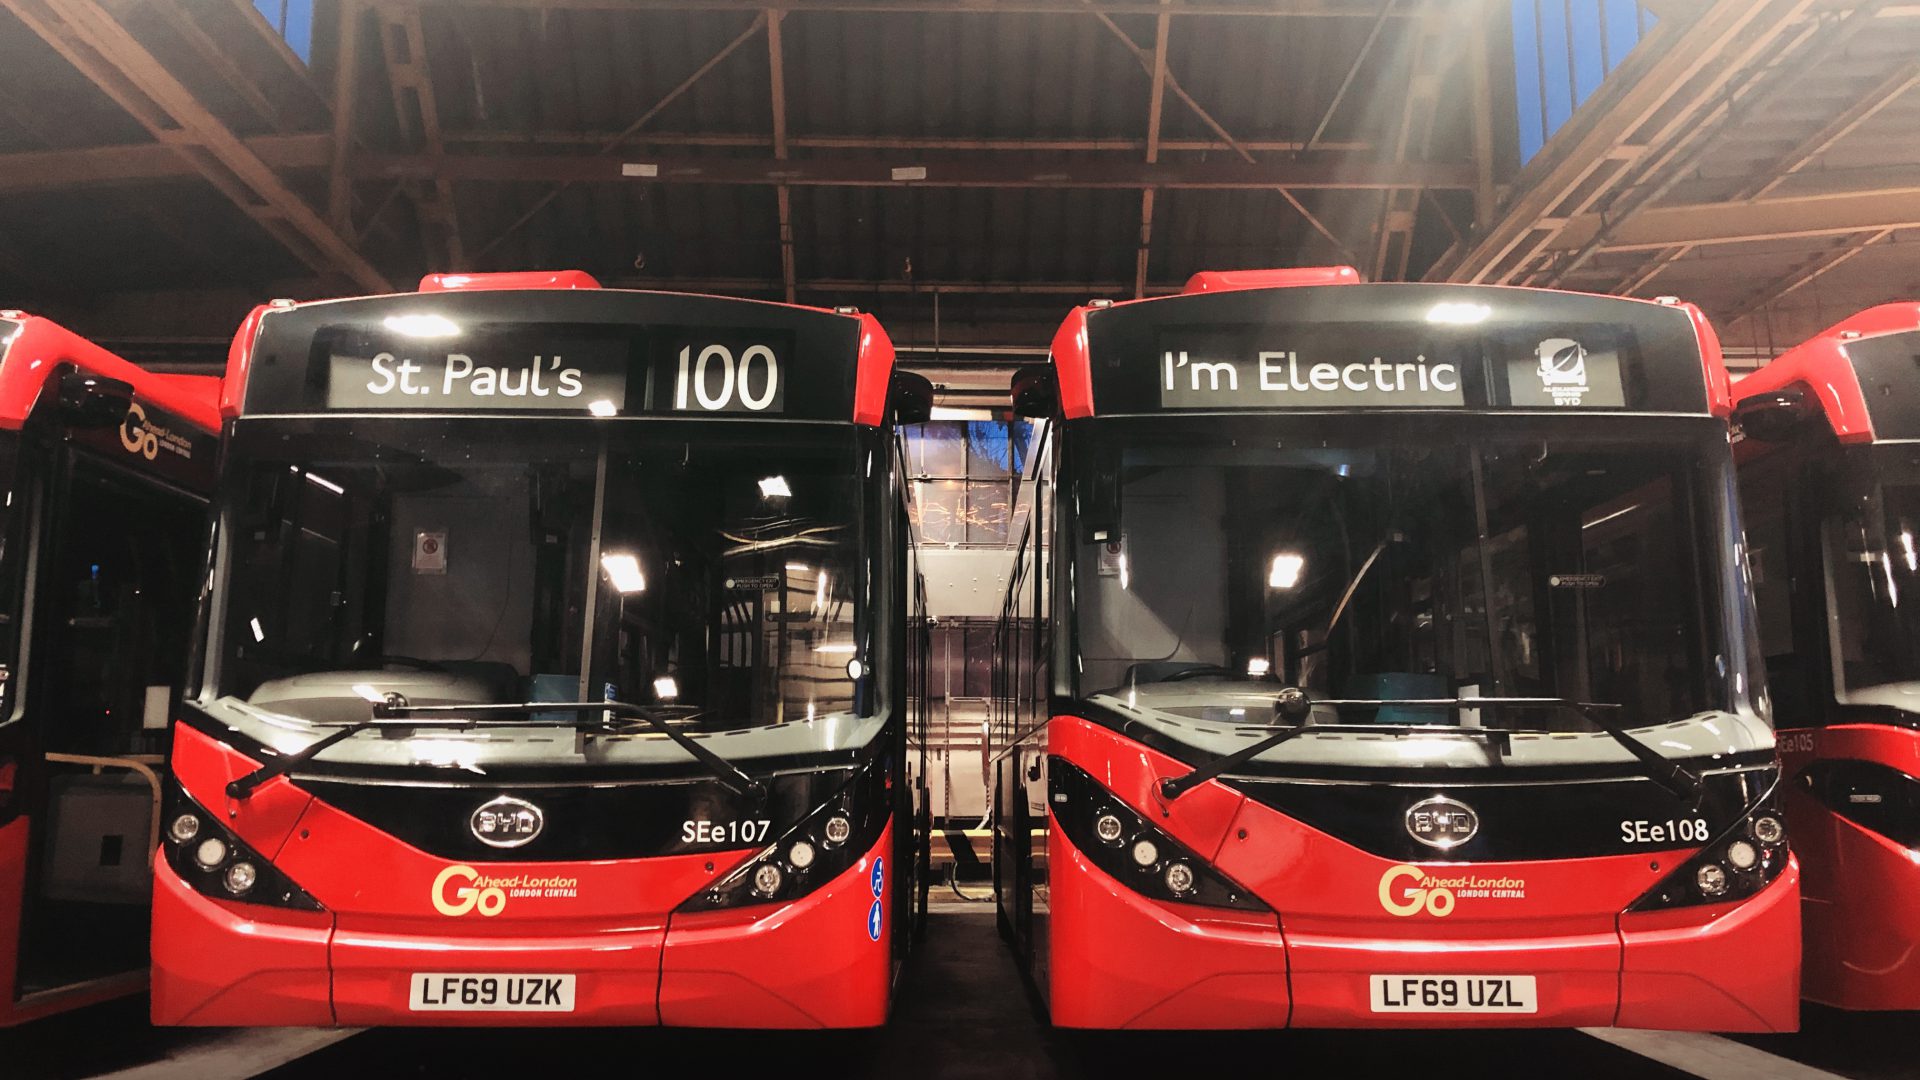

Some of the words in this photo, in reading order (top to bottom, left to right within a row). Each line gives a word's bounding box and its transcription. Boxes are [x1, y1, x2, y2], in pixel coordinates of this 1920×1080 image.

[366, 352, 430, 395] St.
[442, 353, 583, 398] Paul's
[677, 344, 778, 410] 100
[1164, 351, 1238, 391] I'm
[1259, 351, 1457, 392] Electric
[1553, 397, 1581, 406] BYD
[119, 402, 159, 461] Go
[478, 811, 535, 832] BYD
[681, 820, 771, 844] SEe107
[1414, 811, 1470, 833] BYD
[1620, 819, 1709, 844] SEe108
[431, 865, 506, 917] Go
[473, 874, 577, 888] Ahead-London
[509, 888, 542, 897] LONDON
[544, 888, 577, 897] CENTRAL
[1378, 864, 1455, 917] Go
[1420, 875, 1525, 888] Ahead-London
[1457, 889, 1490, 898] LONDON
[1492, 889, 1525, 898] CENTRAL
[422, 977, 498, 1005] LF69
[506, 978, 563, 1005] UZK
[1383, 979, 1458, 1006] LF69
[1467, 979, 1524, 1006] UZL
